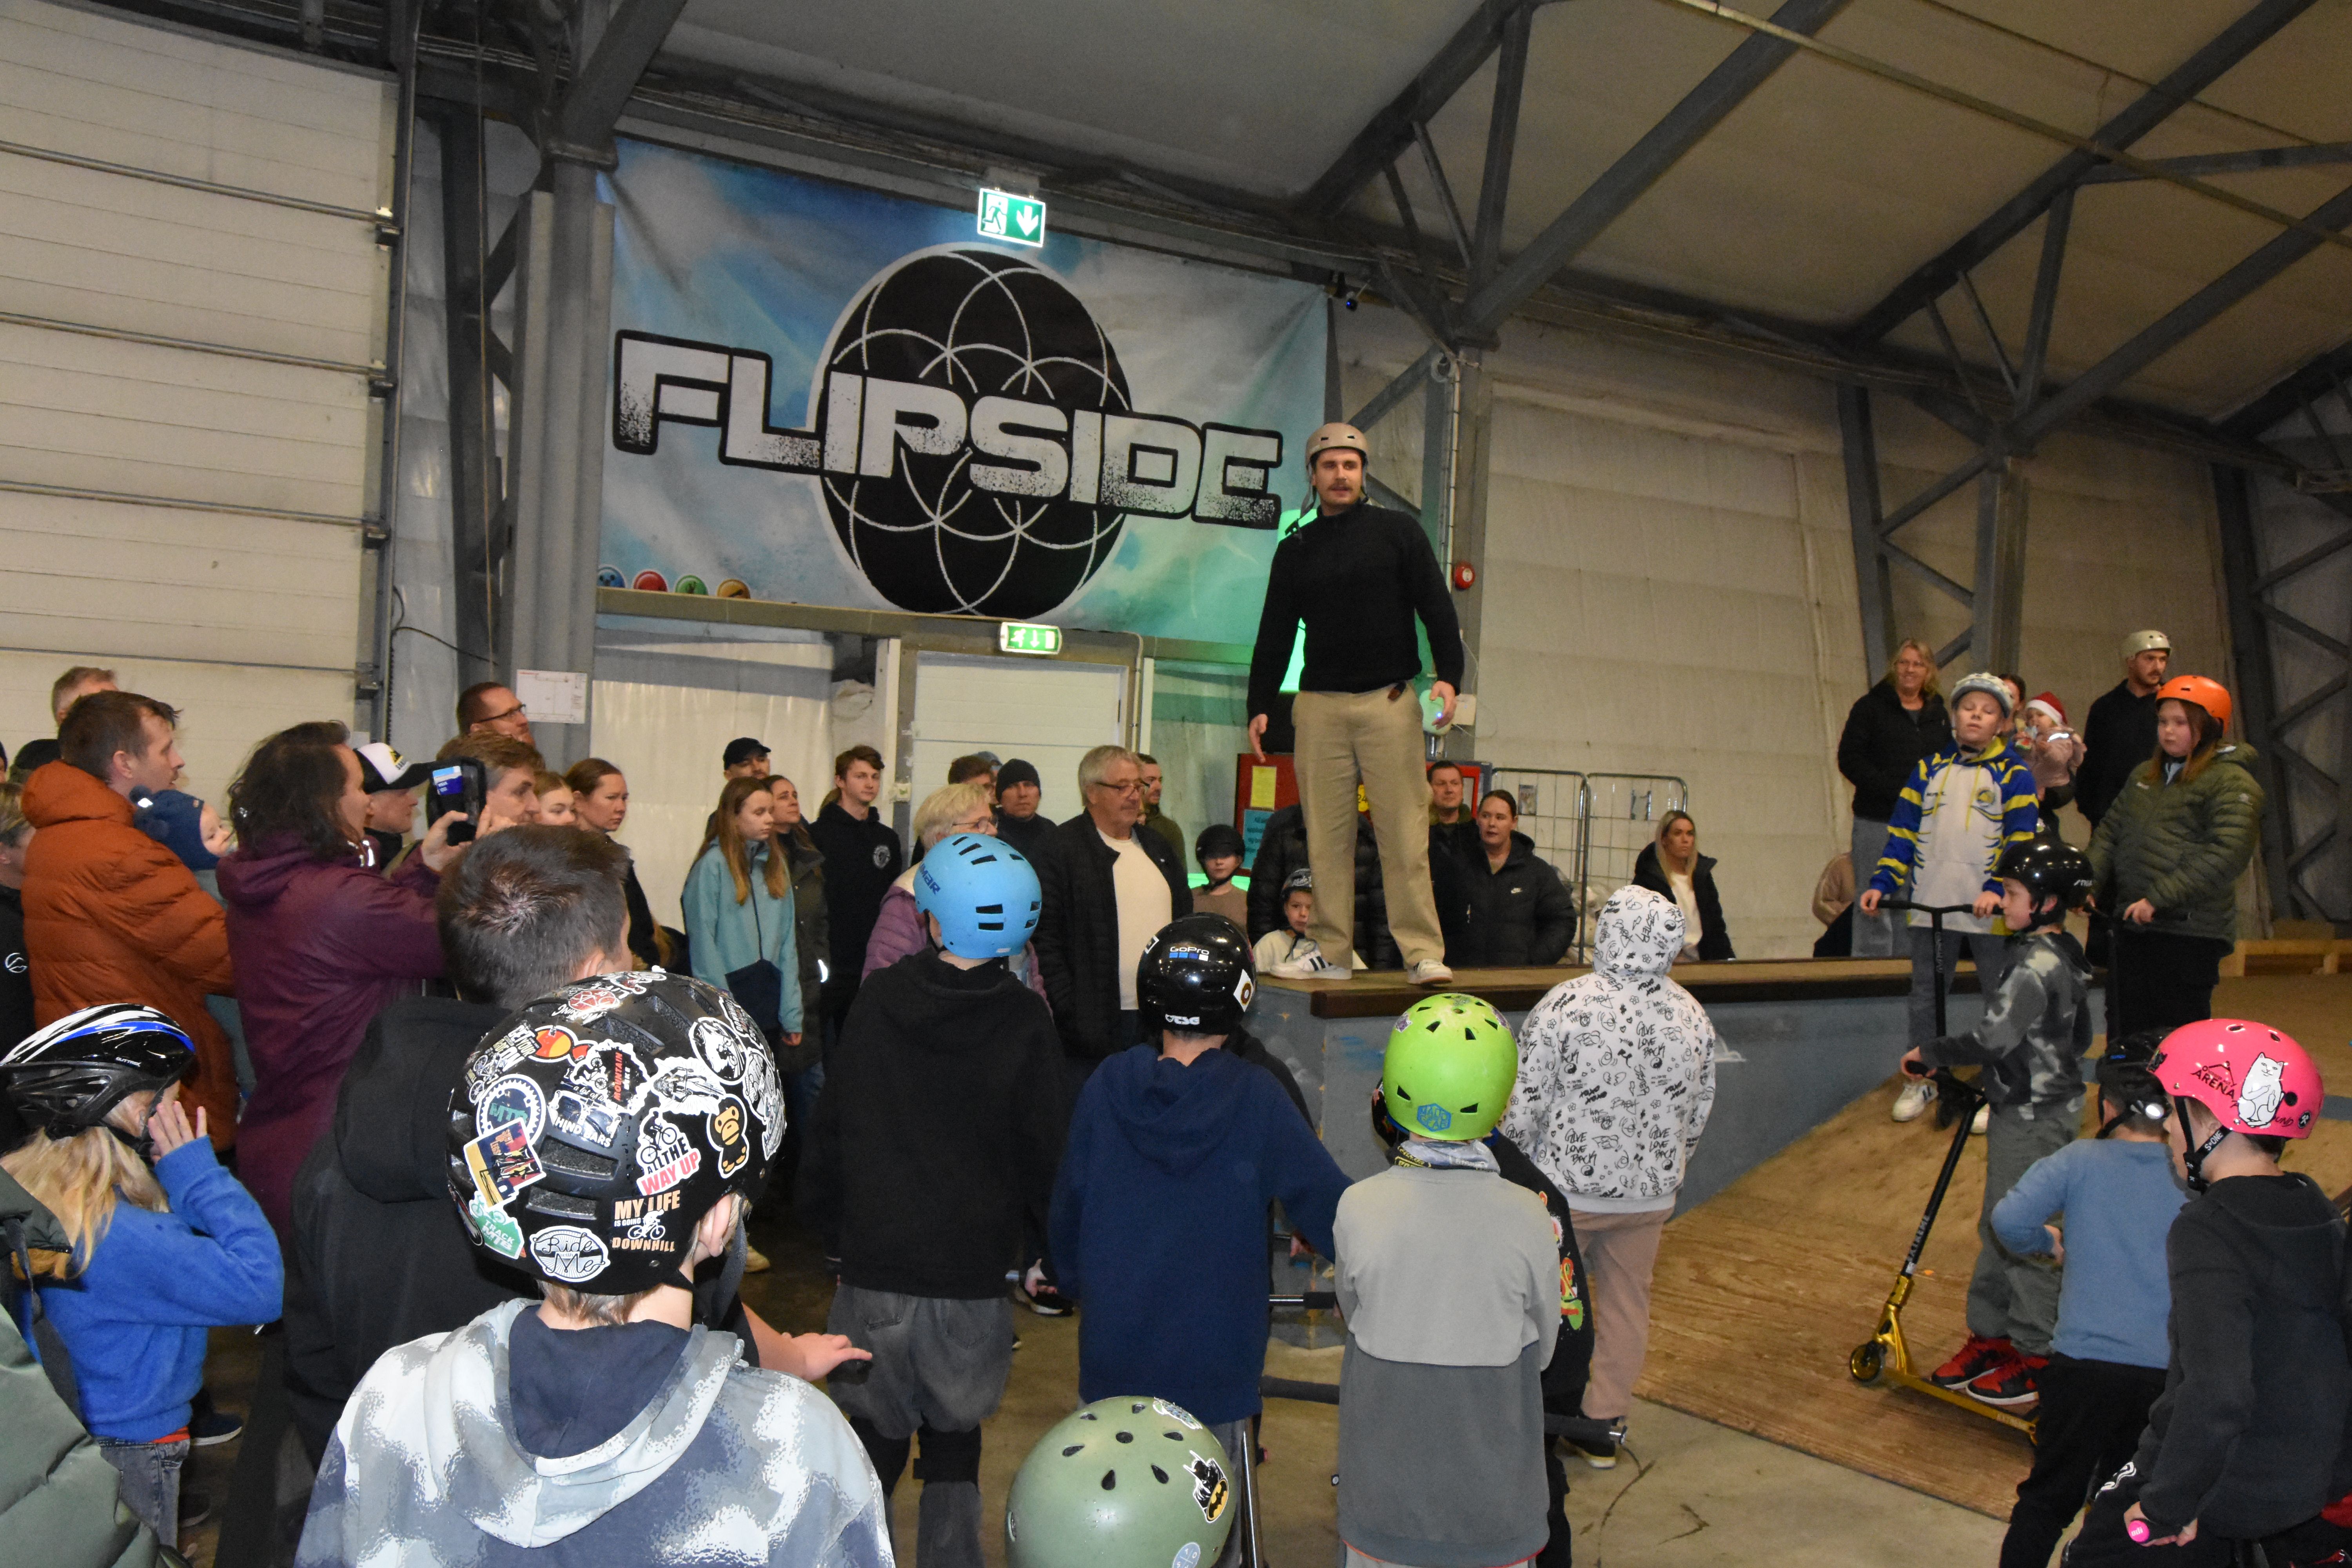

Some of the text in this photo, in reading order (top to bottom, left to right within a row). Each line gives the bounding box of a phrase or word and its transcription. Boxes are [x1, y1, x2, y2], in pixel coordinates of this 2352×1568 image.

[612, 329, 1283, 529] FLIPSIDE
[1170, 947, 1209, 955] GoPro
[508, 1025, 535, 1043] GET
[1638, 1037, 1657, 1050] LOVE
[516, 1038, 536, 1057] YOUR
[614, 1051, 623, 1101] MOUNTAIN
[2190, 1069, 2235, 1099] ARENA
[661, 1136, 689, 1165] THE
[1565, 1144, 1588, 1156] LOVE
[1649, 1140, 1670, 1153] LOVE
[641, 1151, 699, 1195] WAY UP
[614, 1189, 681, 1220] MY LIFE
[485, 1220, 515, 1244] TRACK
[622, 1218, 641, 1226] GOING
[481, 1225, 512, 1250] MTB
[538, 1232, 593, 1254] Ride
[612, 1237, 675, 1252] DOWNHILL
[546, 1253, 594, 1274] Me
